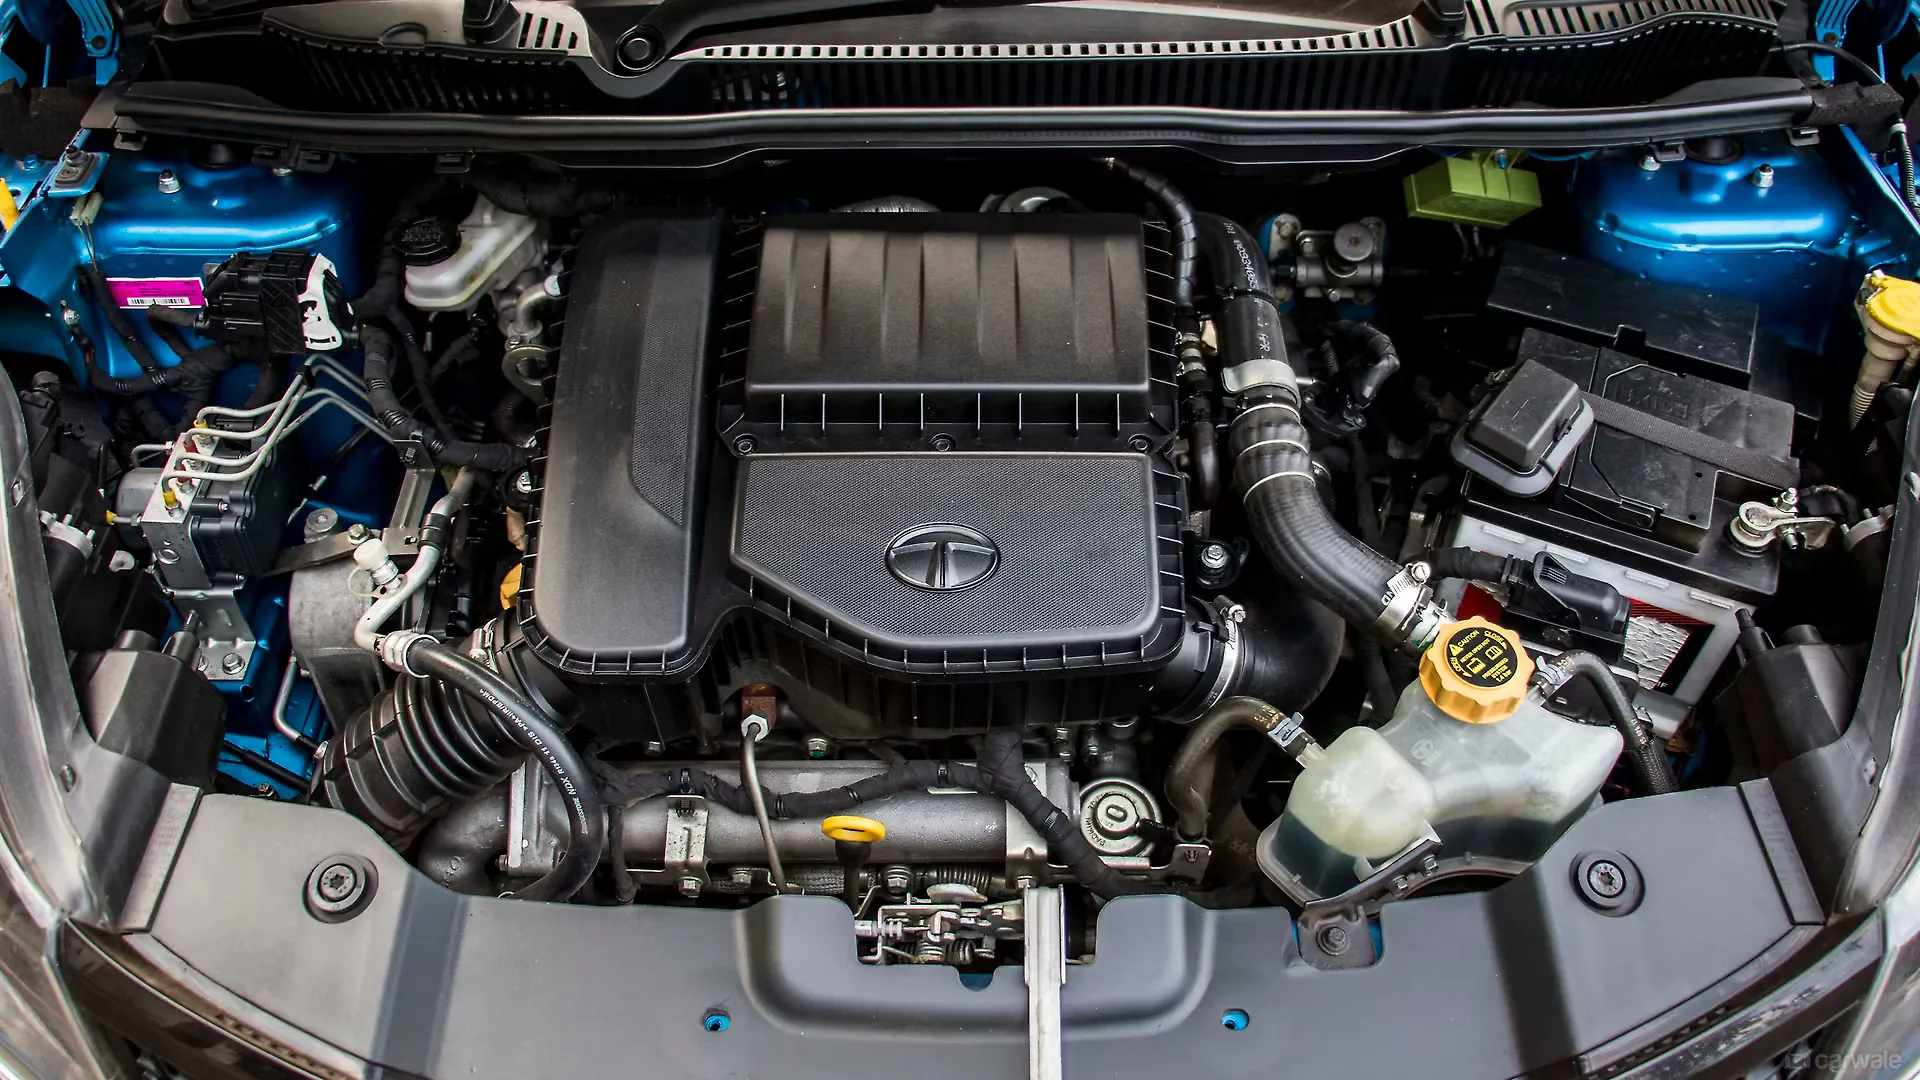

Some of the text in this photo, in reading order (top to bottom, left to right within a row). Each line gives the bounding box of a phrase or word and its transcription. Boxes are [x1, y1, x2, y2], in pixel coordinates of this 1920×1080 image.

[1457, 629, 1480, 647] CAUTION
[1459, 637, 1491, 664] NEVER OPEN HOT
[1490, 664, 1508, 679] SYSTEM
[527, 731, 543, 746] DIS
[549, 755, 565, 775] R134a
[560, 776, 577, 795] NDX
